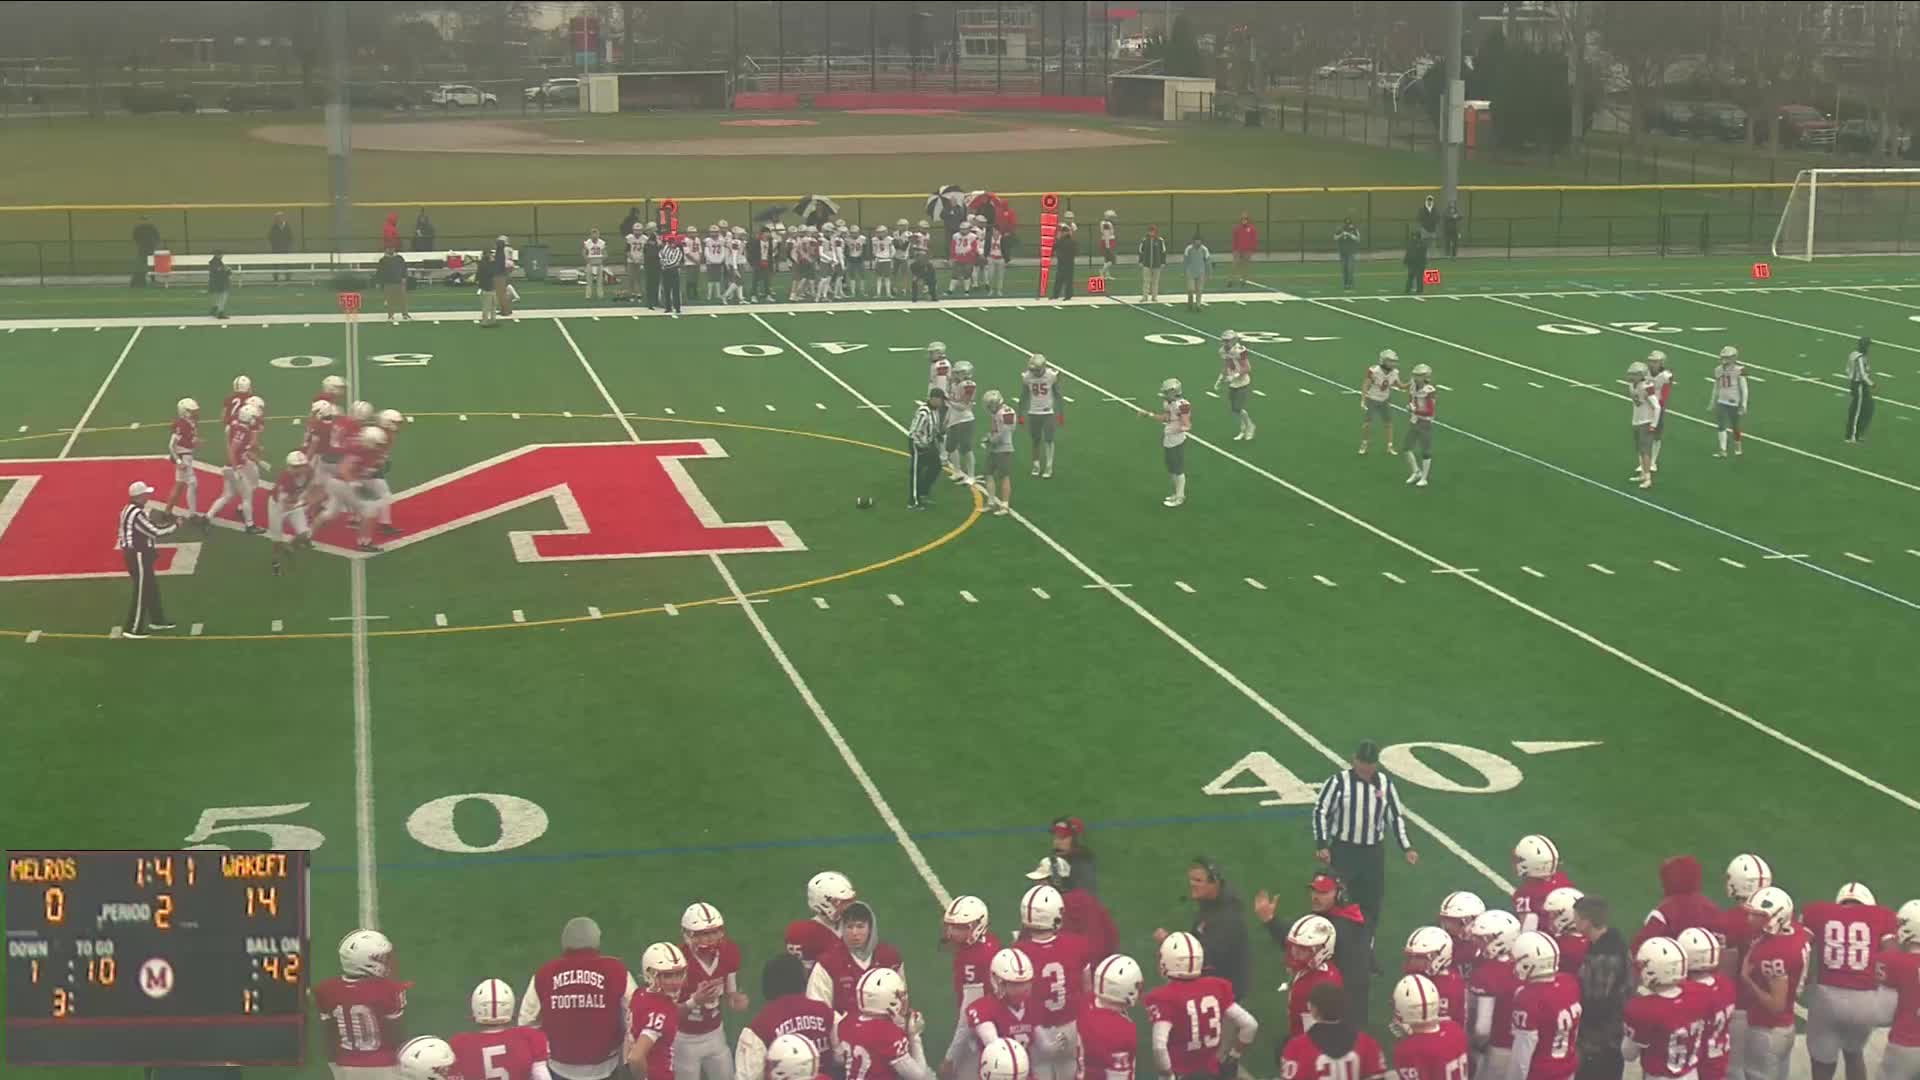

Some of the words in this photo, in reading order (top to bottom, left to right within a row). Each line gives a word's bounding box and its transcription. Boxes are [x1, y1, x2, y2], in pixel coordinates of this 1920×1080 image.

[1090, 278, 1104, 291] 30
[1516, 896, 1531, 913] 21
[1823, 920, 1872, 970] 88
[964, 965, 975, 981] 5
[1761, 960, 1785, 977] 68
[552, 970, 605, 990] MELROSE
[1041, 962, 1066, 1012] 3
[550, 995, 606, 1010] FOOTBALL
[333, 1004, 381, 1051] 10
[647, 1012, 665, 1031] 16
[775, 1014, 826, 1039] MELROSE
[1186, 995, 1222, 1052] 13
[1667, 1019, 1704, 1072] 67
[482, 1044, 510, 1080] 5
